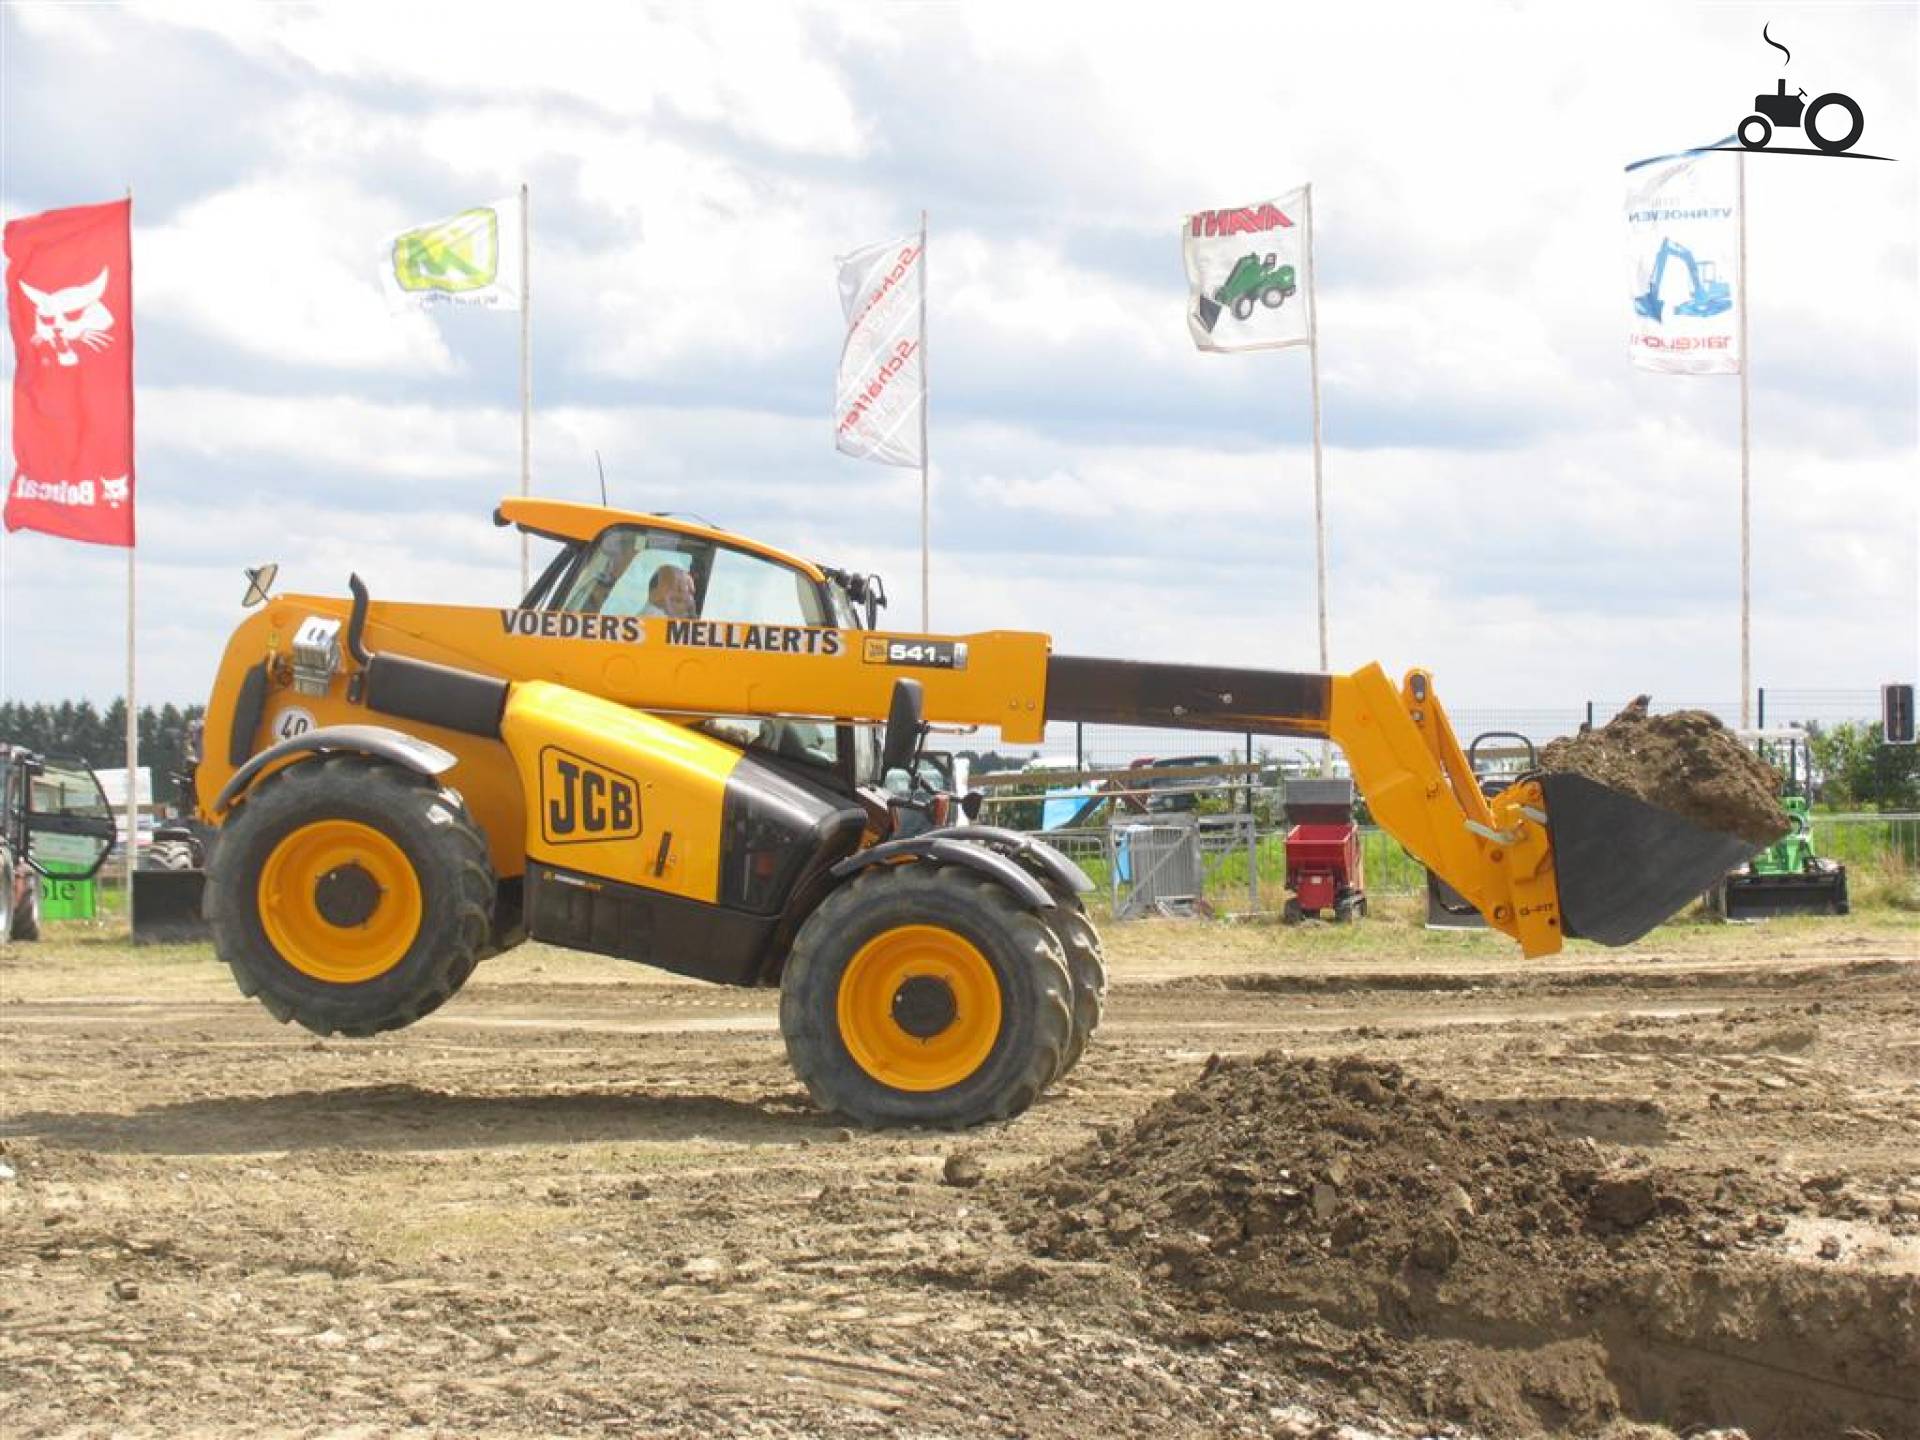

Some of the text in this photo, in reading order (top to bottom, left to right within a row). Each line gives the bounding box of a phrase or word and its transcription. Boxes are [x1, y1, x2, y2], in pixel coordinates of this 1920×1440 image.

[501, 608, 642, 643] VOEDERS
[666, 619, 840, 655] MELLAERTS
[550, 759, 633, 835] JCB
